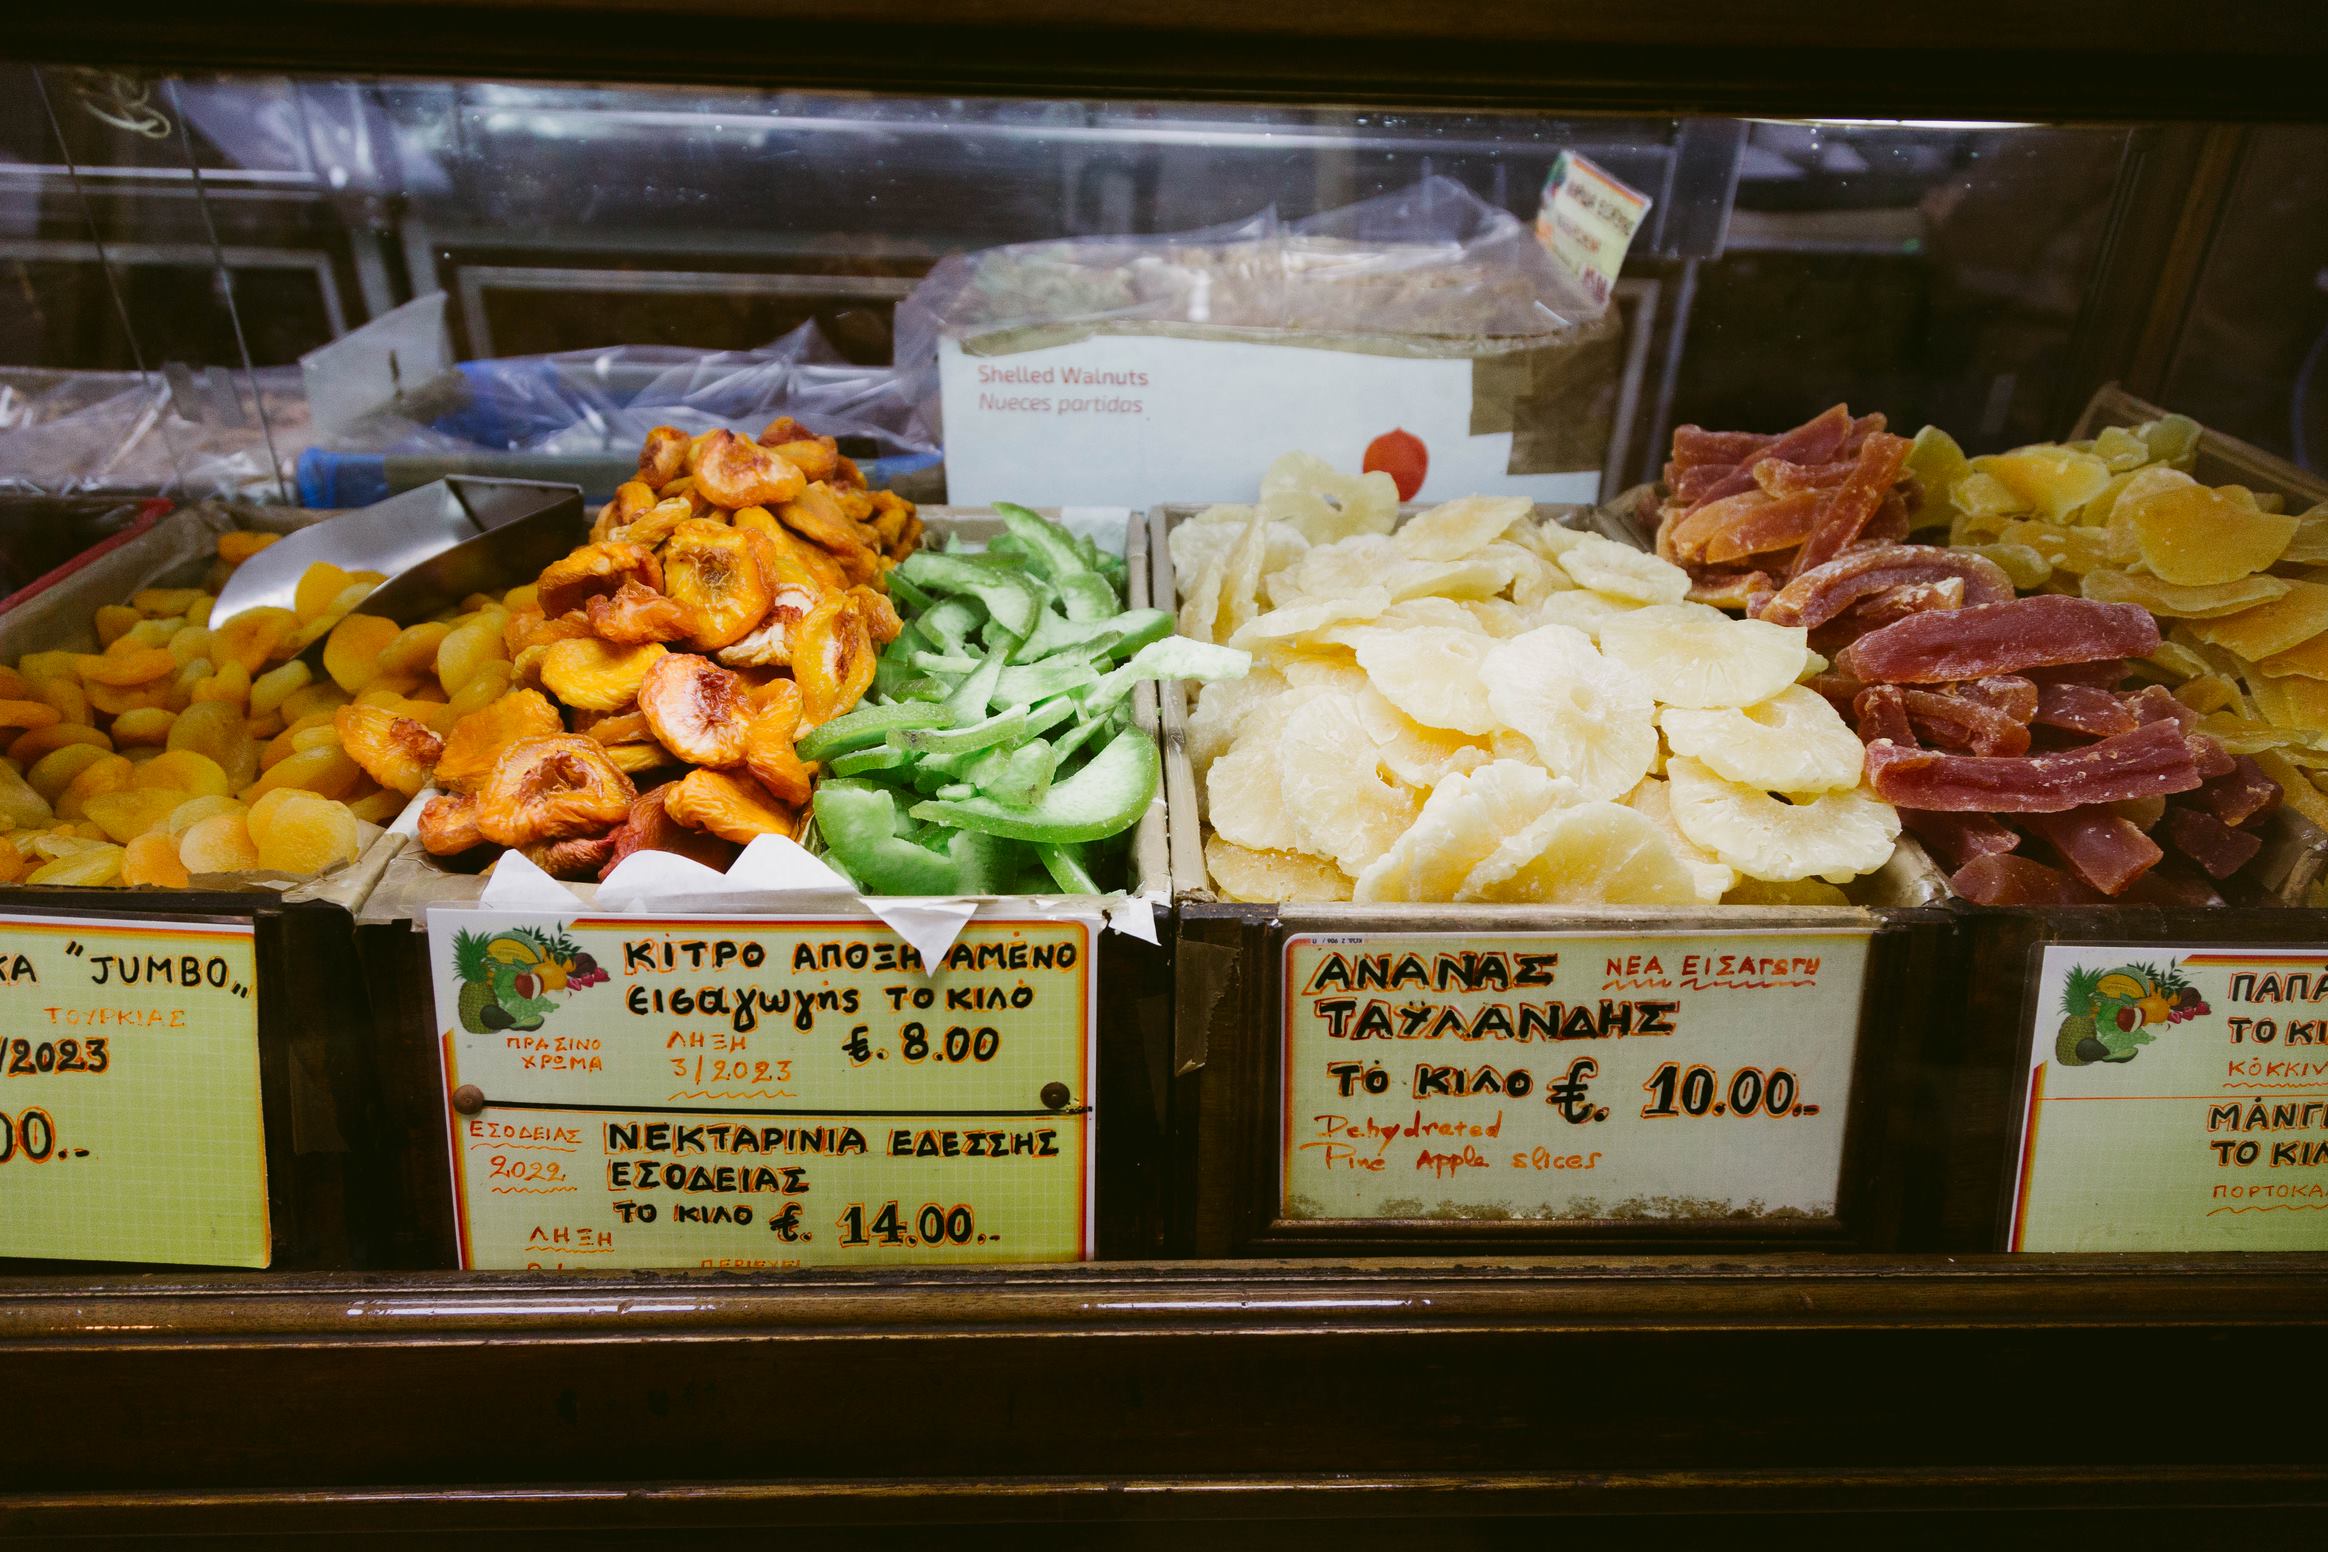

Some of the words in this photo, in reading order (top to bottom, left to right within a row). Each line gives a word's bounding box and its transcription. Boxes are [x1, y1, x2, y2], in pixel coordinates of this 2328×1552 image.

[978, 365, 1055, 384] Shelled
[1060, 367, 1149, 385] Walnuts
[979, 392, 1051, 411] Nueces
[1057, 395, 1144, 414] partidas
[1302, 951, 1557, 996] ΑΝΑΝΑΣ
[1606, 955, 1664, 976] ΝΕΑ
[885, 985, 935, 1012] ΤΟ
[43, 1007, 186, 1027] ΤΟΥΡΚΙΑΣ
[2228, 1017, 2277, 1044] ΤΟ
[506, 1036, 601, 1051] ΠΡΑΣΙΝΟ
[666, 1031, 747, 1053] ΛΗΞΗ
[899, 1021, 1001, 1064] 8.00
[520, 1054, 602, 1072] ΧΡΩΜΑ
[670, 1055, 793, 1085] 3/2023
[1412, 1063, 1533, 1098] ΚΙΛΟ
[470, 1120, 582, 1144] ΕΣΟΔΕΙΑΣ
[604, 1121, 867, 1157] ΝΕΚΤΑΡΙΝΙΑ
[887, 1128, 1059, 1158] ΕΔΕΣΣΗΣ
[1314, 1110, 1502, 1156] Dehydrated
[1300, 1142, 1386, 1170] Pine
[1416, 1144, 1490, 1178] Apple
[1511, 1146, 1603, 1170] slices
[2210, 1140, 2260, 1168] ΤΟ
[489, 1155, 567, 1182] 2022
[608, 1159, 809, 1195] ΕΣΟΔΕΙΑΣ
[2213, 1184, 2328, 1199] ΠΟΡΤΟΚΑ
[613, 1200, 657, 1224] ΤΟ
[674, 1203, 754, 1226] ΚΙΛΟ
[530, 1226, 611, 1246] ΛΗΞΗ
